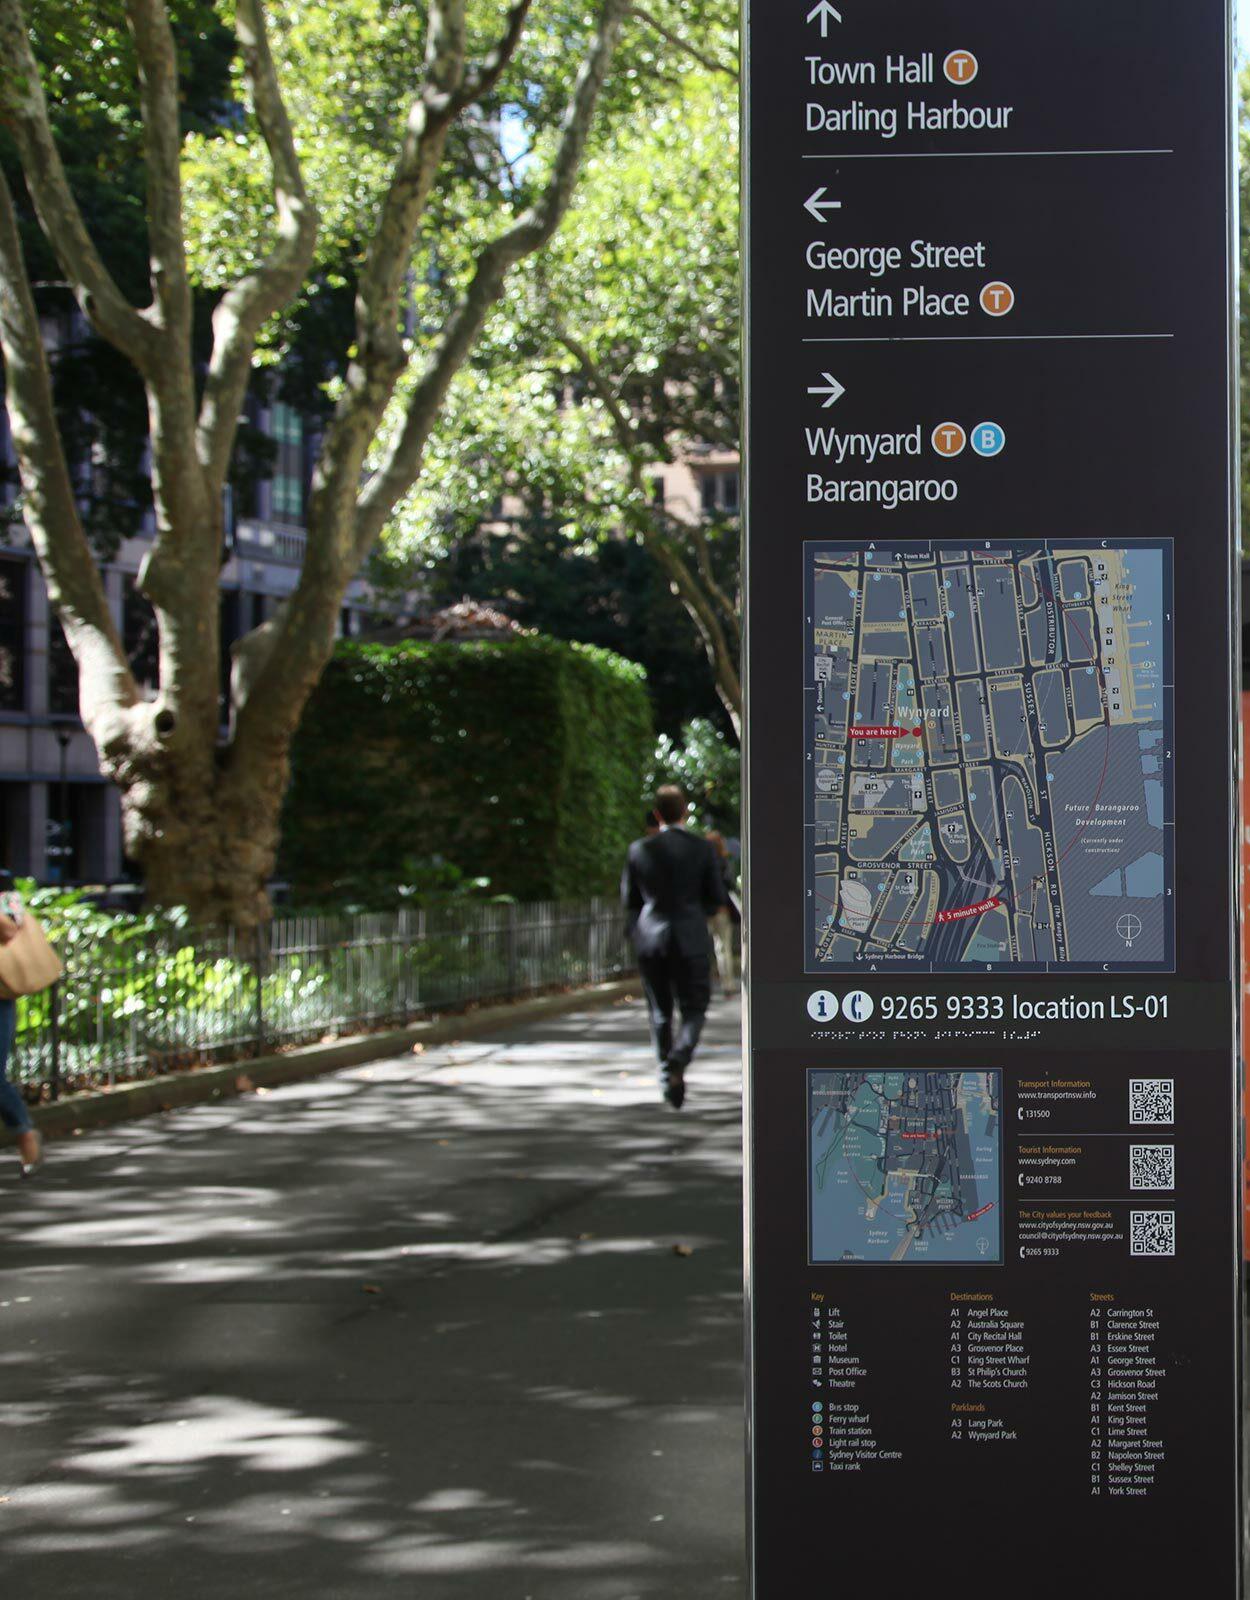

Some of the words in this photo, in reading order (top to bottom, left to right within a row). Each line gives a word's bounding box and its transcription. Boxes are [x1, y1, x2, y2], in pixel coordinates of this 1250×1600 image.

[805, 56, 875, 84] Town
[887, 53, 933, 83] Hall
[807, 101, 896, 138] Darling
[908, 99, 1013, 129] Harbour
[806, 241, 901, 276] George
[911, 240, 985, 268] Street
[807, 288, 891, 316] Martin
[904, 286, 969, 315] Place
[805, 425, 921, 463] Wynyard
[807, 474, 957, 509] Barangaroo
[1046, 601, 1056, 655] DISTRIBUTOR
[816, 631, 847, 639] MARTIN
[1025, 682, 1035, 715] SUSSEX
[898, 706, 949, 720] Wynyard
[850, 728, 866, 736] You
[880, 728, 897, 736] here
[1095, 804, 1139, 813] Barangaroo
[1075, 818, 1126, 826] Development
[1044, 831, 1054, 872] HICKSON
[953, 906, 977, 919] minute
[978, 901, 995, 912] walk
[881, 996, 937, 1019] 9265
[947, 996, 1003, 1019] 9333
[1014, 995, 1103, 1019] location
[1111, 996, 1167, 1018] LS-01
[1018, 1080, 1049, 1089] Transport
[1018, 1091, 1096, 1100] www.transportnsw.info
[1018, 1157, 1075, 1166] www.sydney.com
[1045, 1176, 1062, 1184] 8788
[1032, 1211, 1044, 1220] City
[811, 1293, 824, 1302] Key
[951, 1293, 993, 1301] Destinations
[1090, 1293, 1114, 1301] Streets
[829, 1308, 840, 1316] Lift
[968, 1308, 988, 1319] Angel
[990, 1308, 1008, 1316] Place
[1107, 1309, 1144, 1319] Carrington
[829, 1320, 844, 1328] Stair
[951, 1320, 961, 1328] A2
[1000, 1320, 1024, 1330] Square
[1107, 1320, 1137, 1328] Clarence
[1139, 1321, 1159, 1329] Street
[829, 1332, 847, 1340] Toilet
[951, 1332, 959, 1340] A1
[968, 1332, 981, 1342] City
[984, 1332, 1006, 1340] Recital
[1009, 1332, 1022, 1340] Hall
[1091, 1332, 1098, 1340] B1
[1108, 1332, 1132, 1340] Erskine
[829, 1344, 847, 1352] Hotel
[951, 1344, 961, 1352] A3
[968, 1344, 1003, 1352] Grosvenor
[1006, 1344, 1023, 1352] Place
[1090, 1344, 1100, 1352] A3
[1108, 1344, 1126, 1352] Essex
[829, 1356, 859, 1364] Museum
[951, 1356, 959, 1364] C1
[968, 1356, 984, 1366] King
[986, 1356, 1005, 1364] Street
[1008, 1356, 1030, 1364] Wharf
[1091, 1356, 1099, 1364] A1
[1108, 1356, 1133, 1366] George
[1135, 1356, 1155, 1364] Street
[846, 1367, 867, 1375] Office
[951, 1368, 960, 1376] B3
[968, 1368, 975, 1376] St
[977, 1368, 1000, 1377] Philip's
[1002, 1368, 1027, 1376] Church
[829, 1379, 855, 1387] Theatre
[951, 1380, 961, 1388] A2
[1003, 1380, 1027, 1388] Church
[829, 1403, 842, 1411] Bus
[844, 1404, 859, 1413] stop
[952, 1403, 985, 1411] Parklands
[829, 1415, 846, 1425] Ferry
[848, 1415, 869, 1423] wharf
[951, 1419, 961, 1427] A3
[969, 1419, 985, 1429] Lang
[988, 1419, 1003, 1427] Park
[829, 1427, 846, 1435] Train
[848, 1427, 872, 1435] station
[952, 1431, 961, 1439] A2
[969, 1431, 999, 1441] Wynyard
[1002, 1431, 1017, 1439] Park
[830, 1438, 846, 1448] Light
[849, 1438, 859, 1446] rail
[861, 1440, 876, 1448] stop
[829, 1450, 854, 1460] Sydney
[856, 1450, 877, 1458] Visitor
[879, 1450, 902, 1458] Centre
[830, 1462, 843, 1470] Taxi
[845, 1462, 860, 1470] rank
